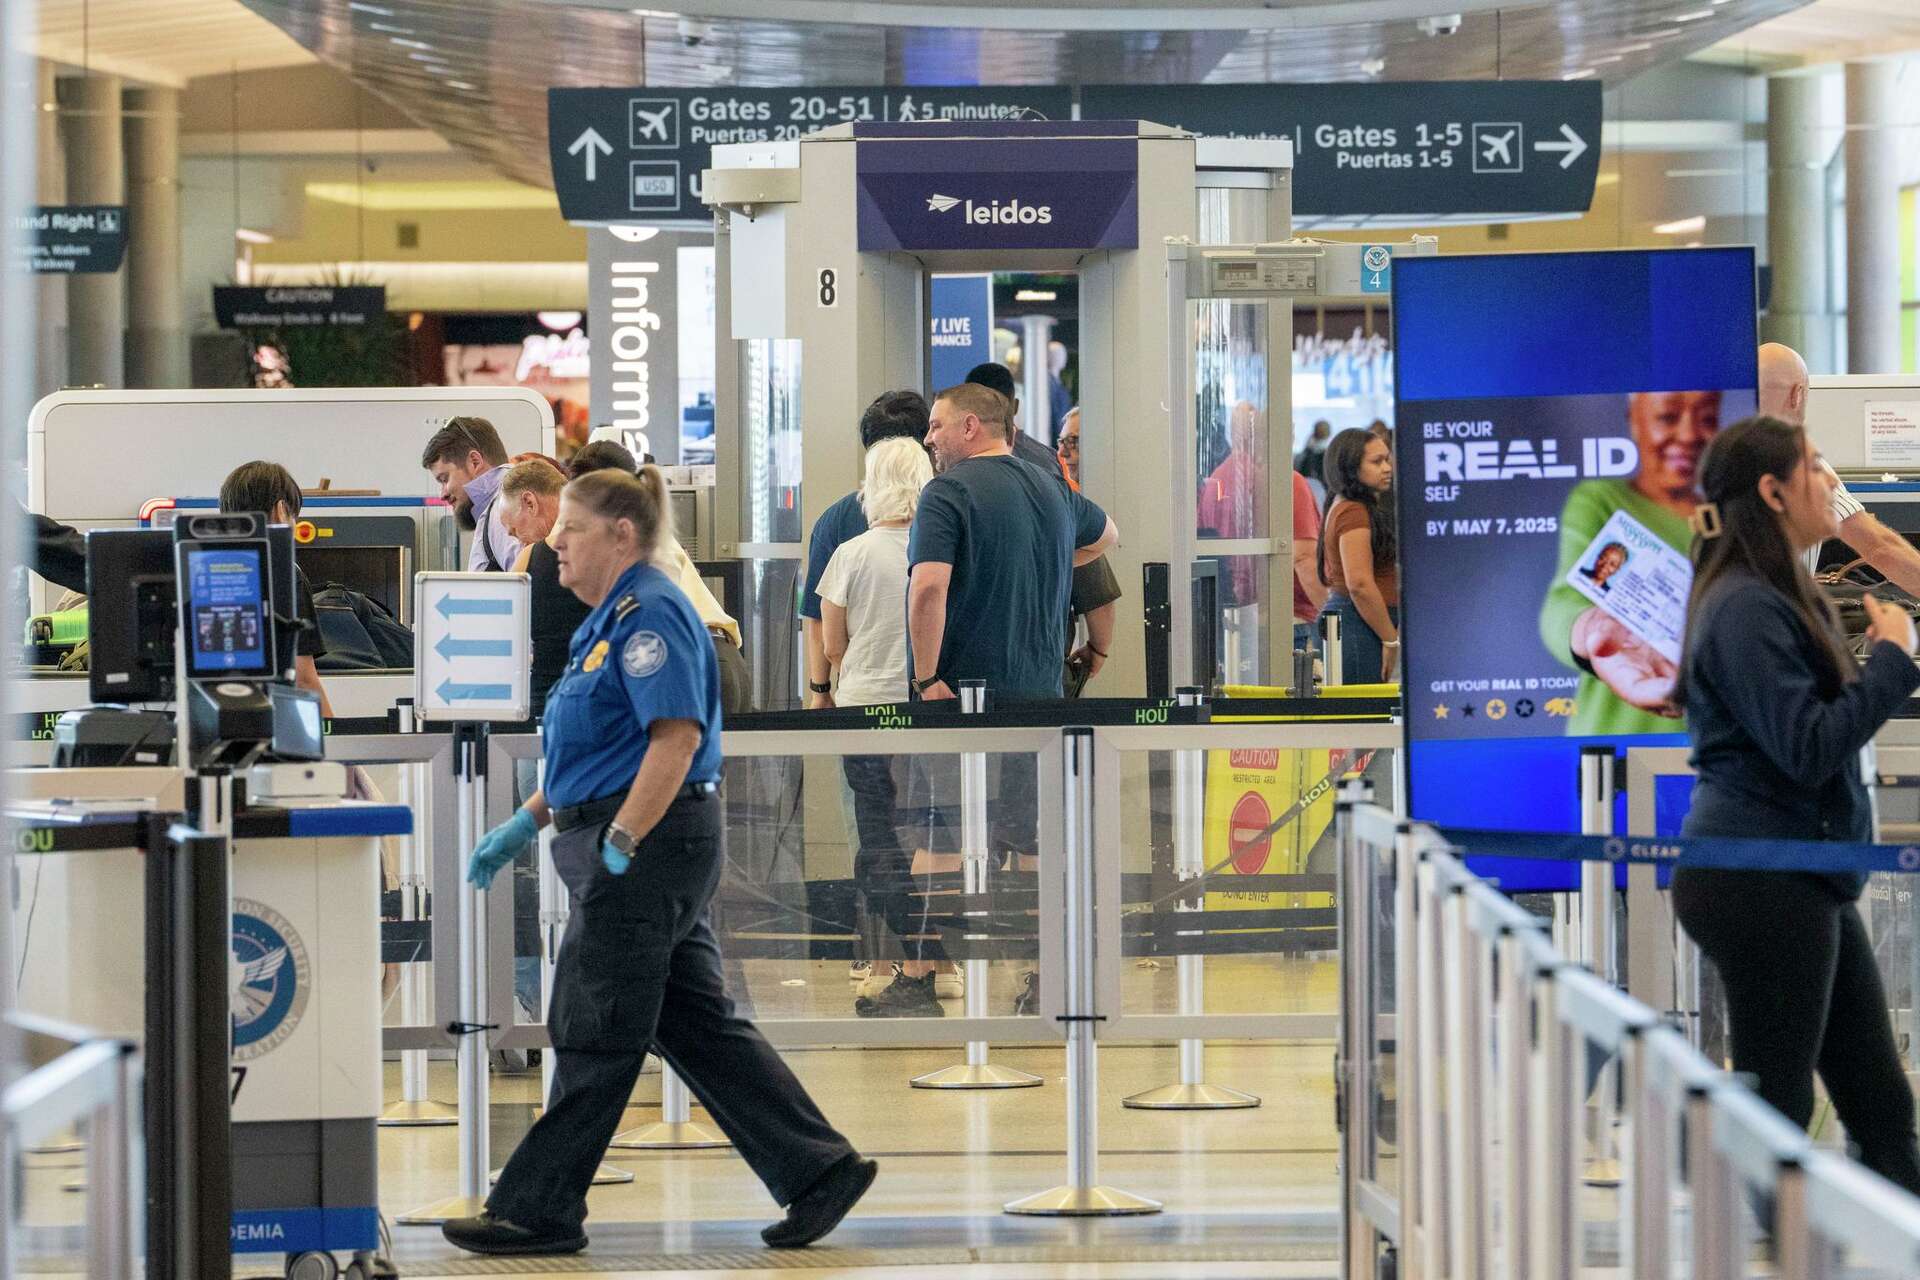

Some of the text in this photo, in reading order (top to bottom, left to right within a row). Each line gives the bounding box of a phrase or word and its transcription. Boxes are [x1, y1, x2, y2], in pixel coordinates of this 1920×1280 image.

[689, 97, 874, 121] Gates 20-51
[922, 102, 1022, 121] 5 minutes
[691, 125, 768, 143] Puertas
[1315, 124, 1397, 148] Gates
[1415, 123, 1463, 146] 1-5
[1337, 150, 1453, 168] Puertas 1-5
[965, 199, 1052, 225] leidos
[52, 213, 95, 233] Right
[819, 269, 836, 306] 8
[1369, 271, 1382, 289] 4
[941, 317, 971, 333] LIVE
[1423, 421, 1493, 438] BE YOUR
[1424, 437, 1639, 482] REAL ID
[1424, 485, 1460, 502] SELF
[1426, 518, 1557, 536] BY MAY 7, 2025
[1430, 677, 1579, 692] GET YOUR REAL ID TODAY
[1135, 708, 1168, 724] HOU
[1231, 750, 1278, 766] CAUTION
[1264, 775, 1276, 784] AREA
[1300, 777, 1330, 808] HOU
